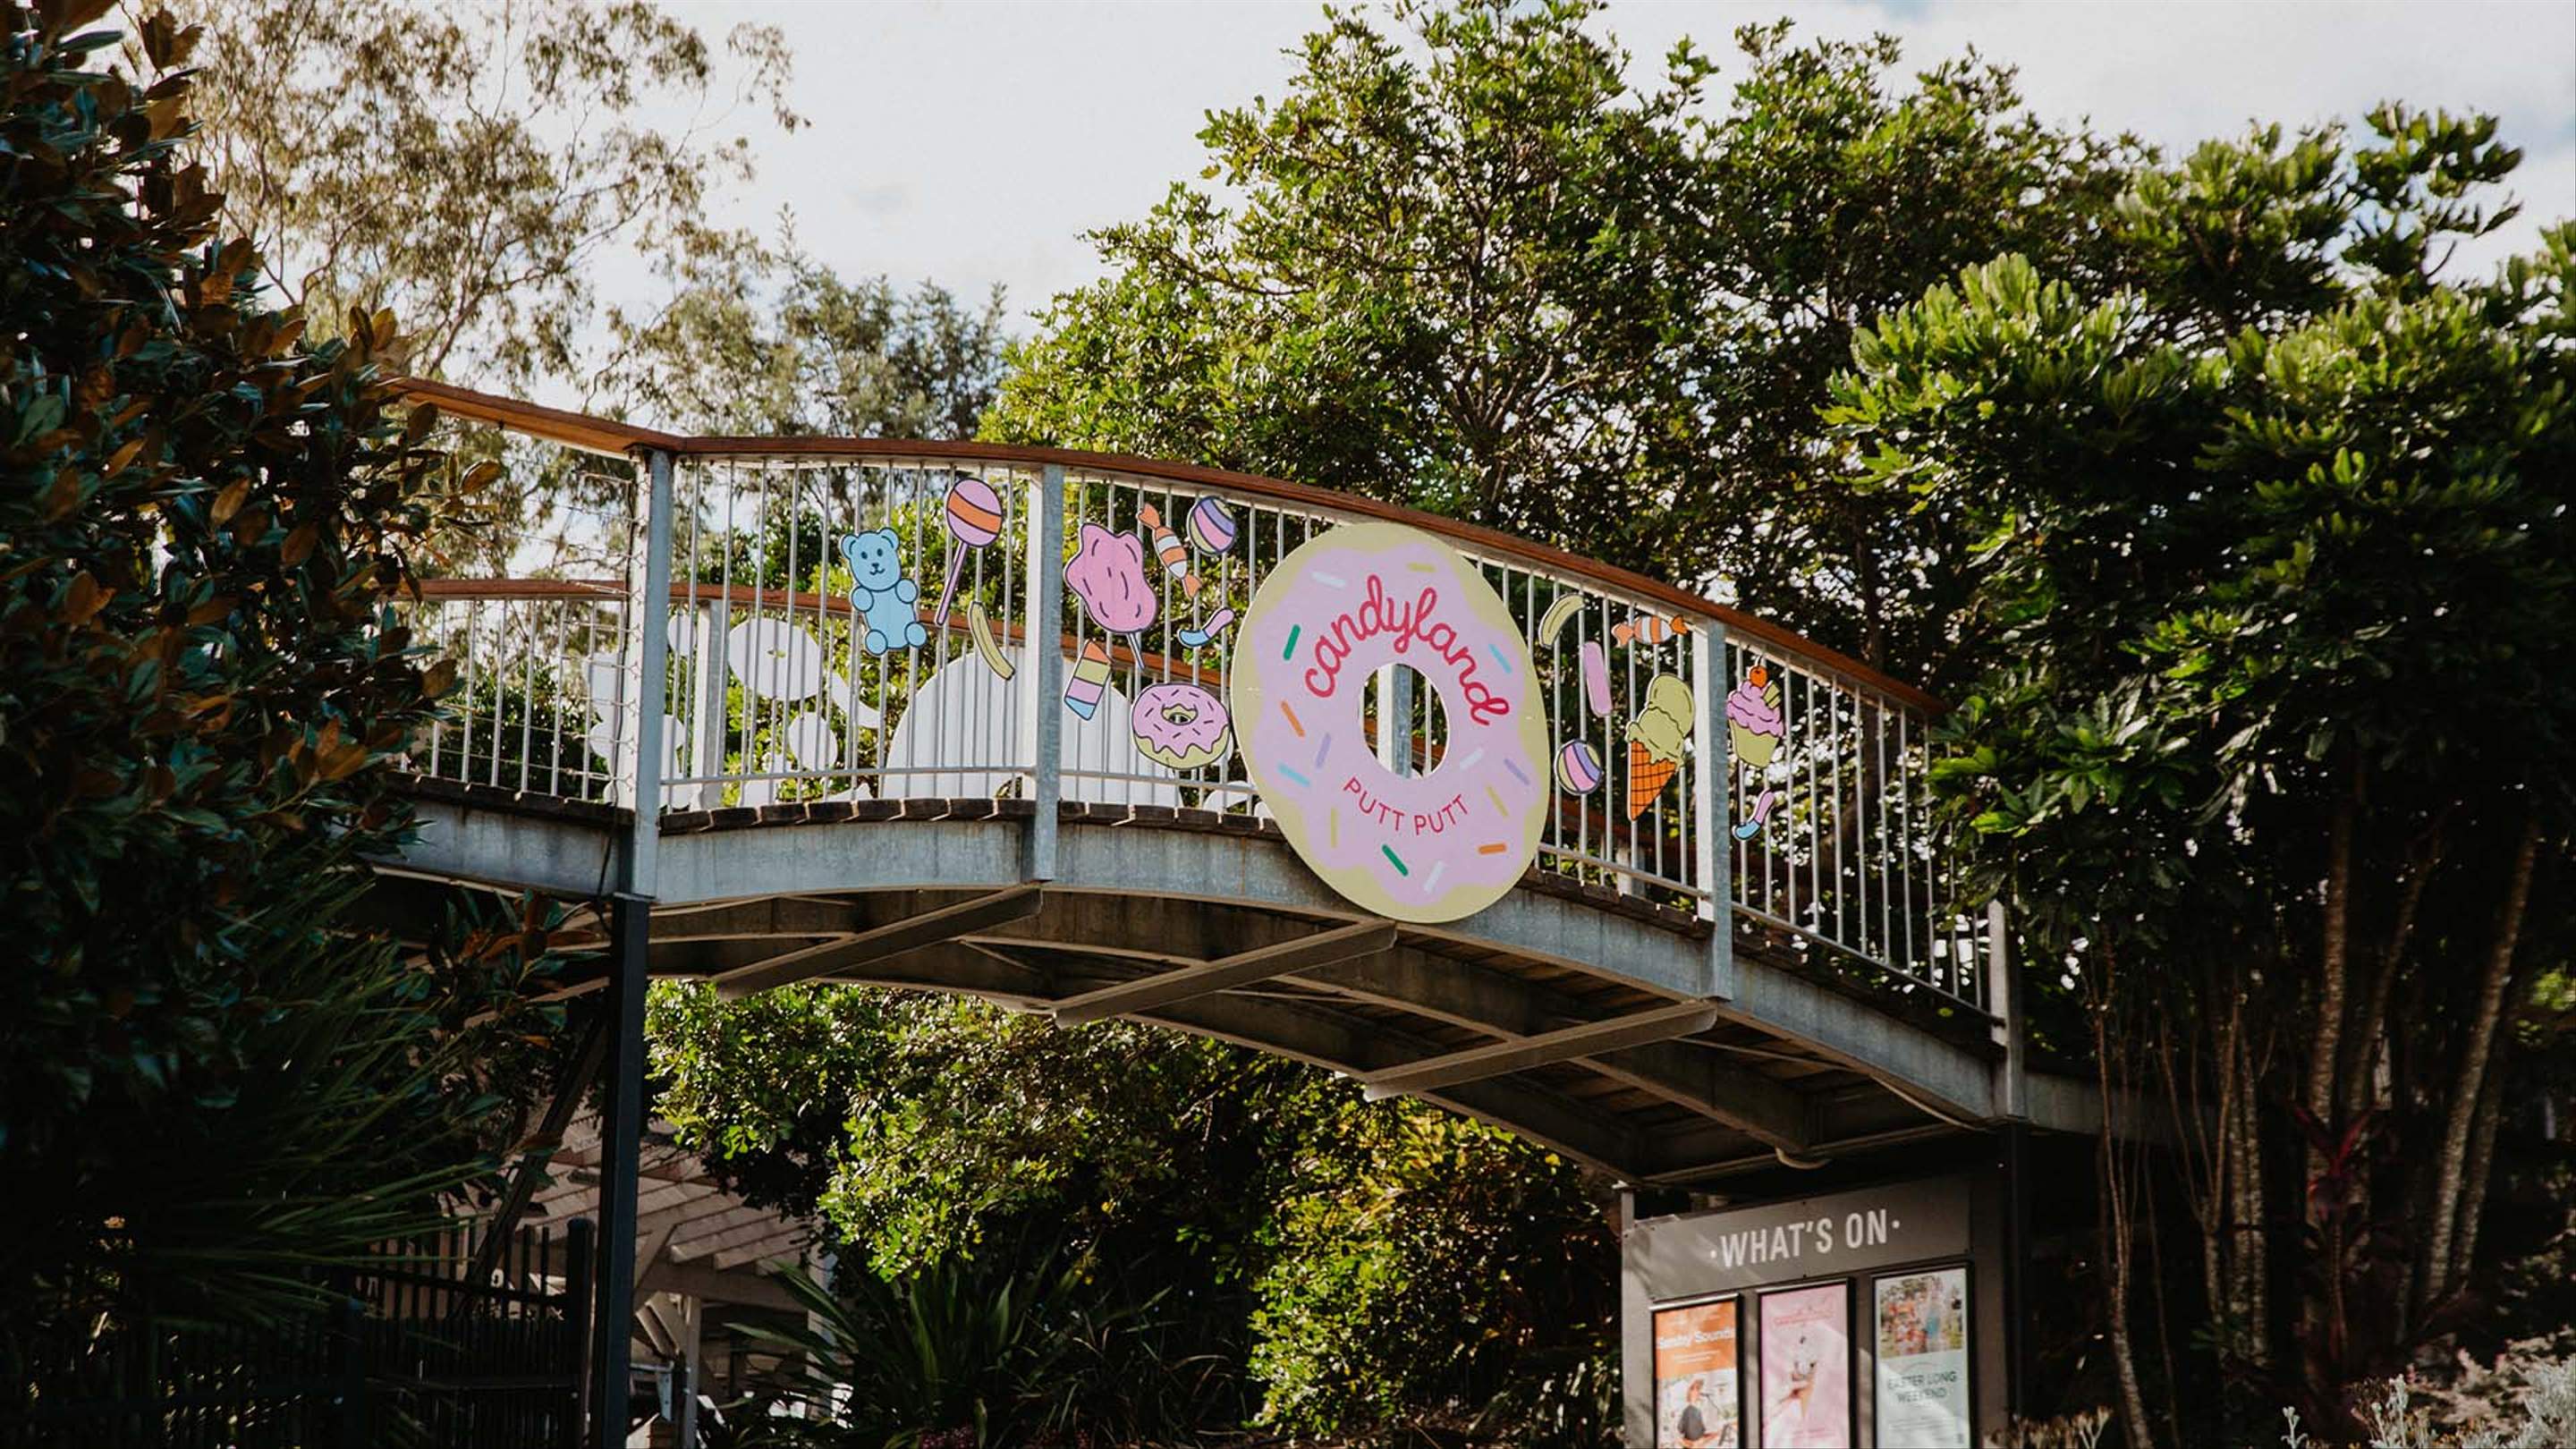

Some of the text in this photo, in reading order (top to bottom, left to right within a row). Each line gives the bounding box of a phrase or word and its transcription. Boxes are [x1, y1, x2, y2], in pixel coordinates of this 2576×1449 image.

[1305, 574, 1511, 726] candyland
[1343, 776, 1469, 835] PUTT PUTT
[1719, 1208, 1889, 1268] WHAT'S ON
